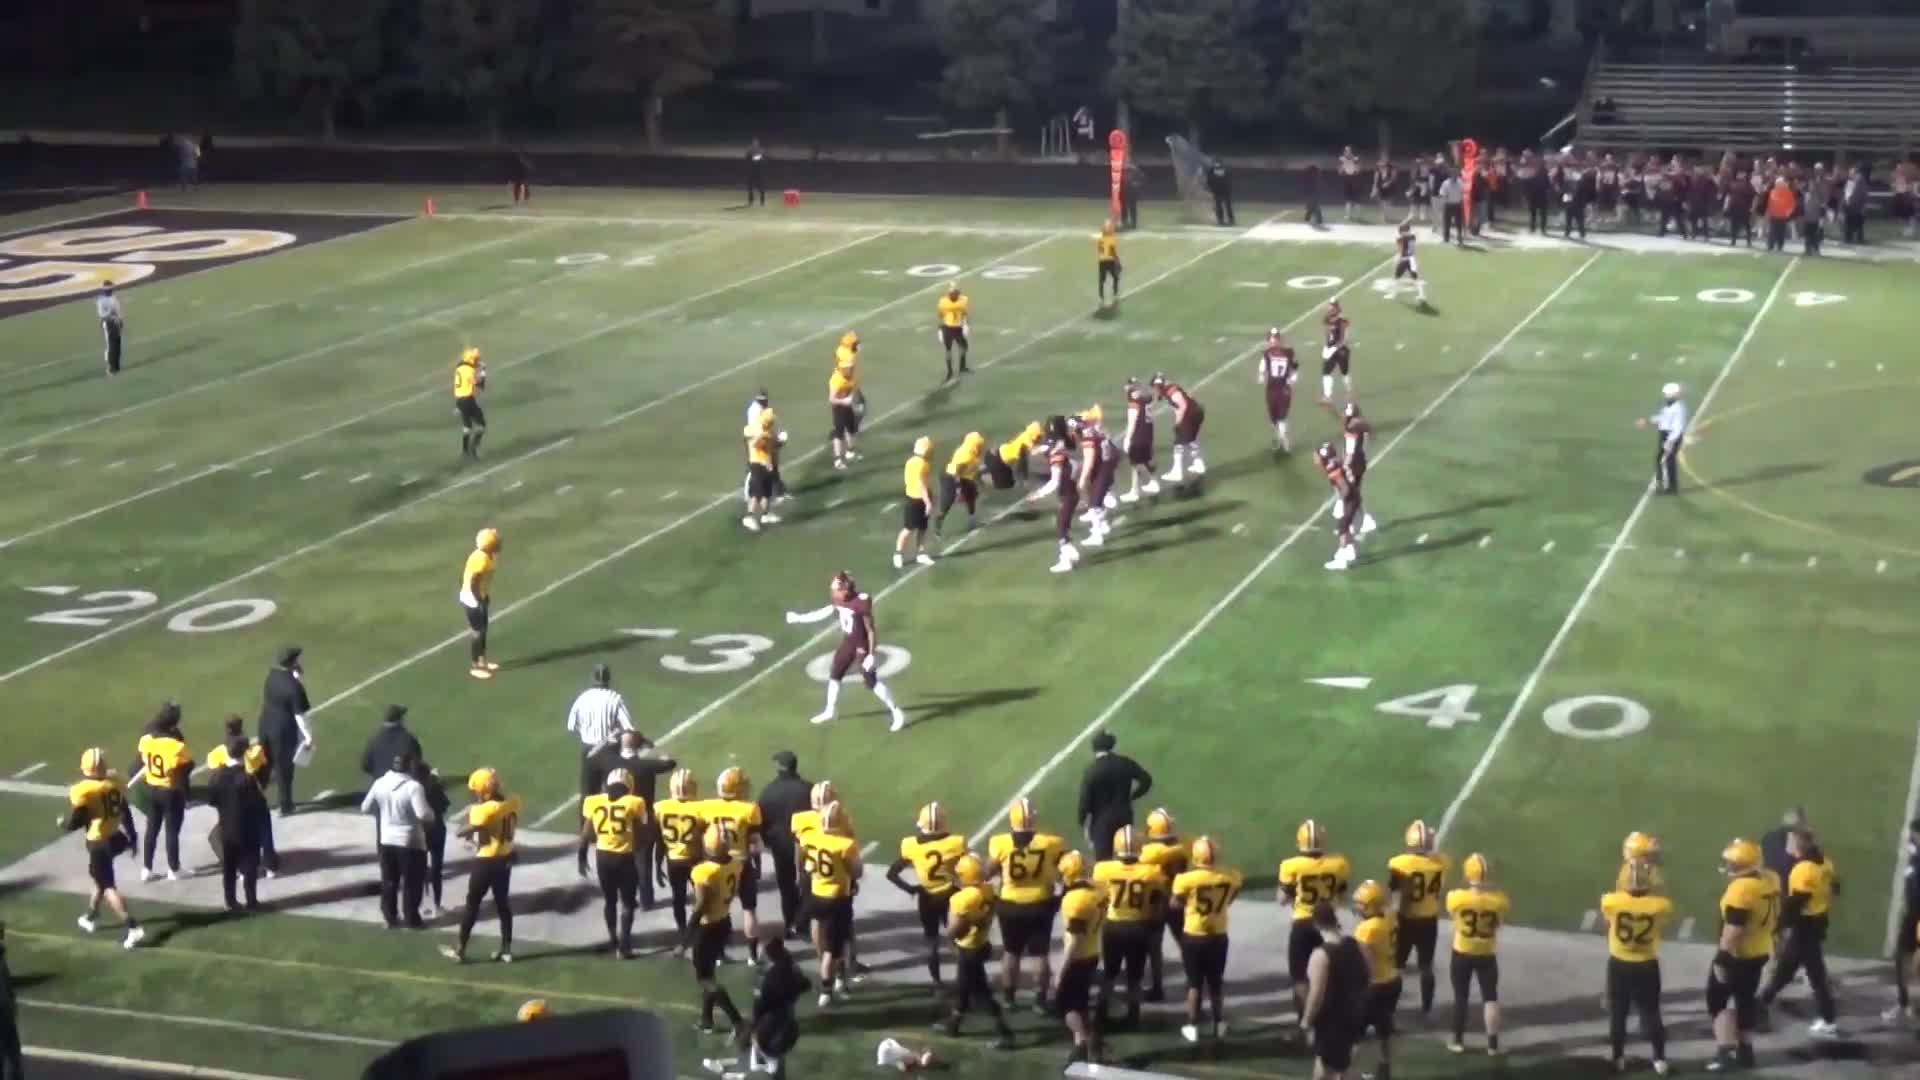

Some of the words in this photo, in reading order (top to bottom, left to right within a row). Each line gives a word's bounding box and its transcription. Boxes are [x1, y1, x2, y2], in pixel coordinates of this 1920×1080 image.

[1696, 288, 1848, 308] 40
[26, 590, 278, 633] 20
[660, 633, 912, 682] 30
[1375, 684, 1651, 740] 40
[147, 752, 165, 779] 19
[593, 805, 627, 835] 25
[662, 814, 699, 843] 52
[926, 849, 945, 881] 2
[1009, 848, 1046, 881] 67
[1196, 883, 1229, 914] 57
[1616, 911, 1654, 945] 62
